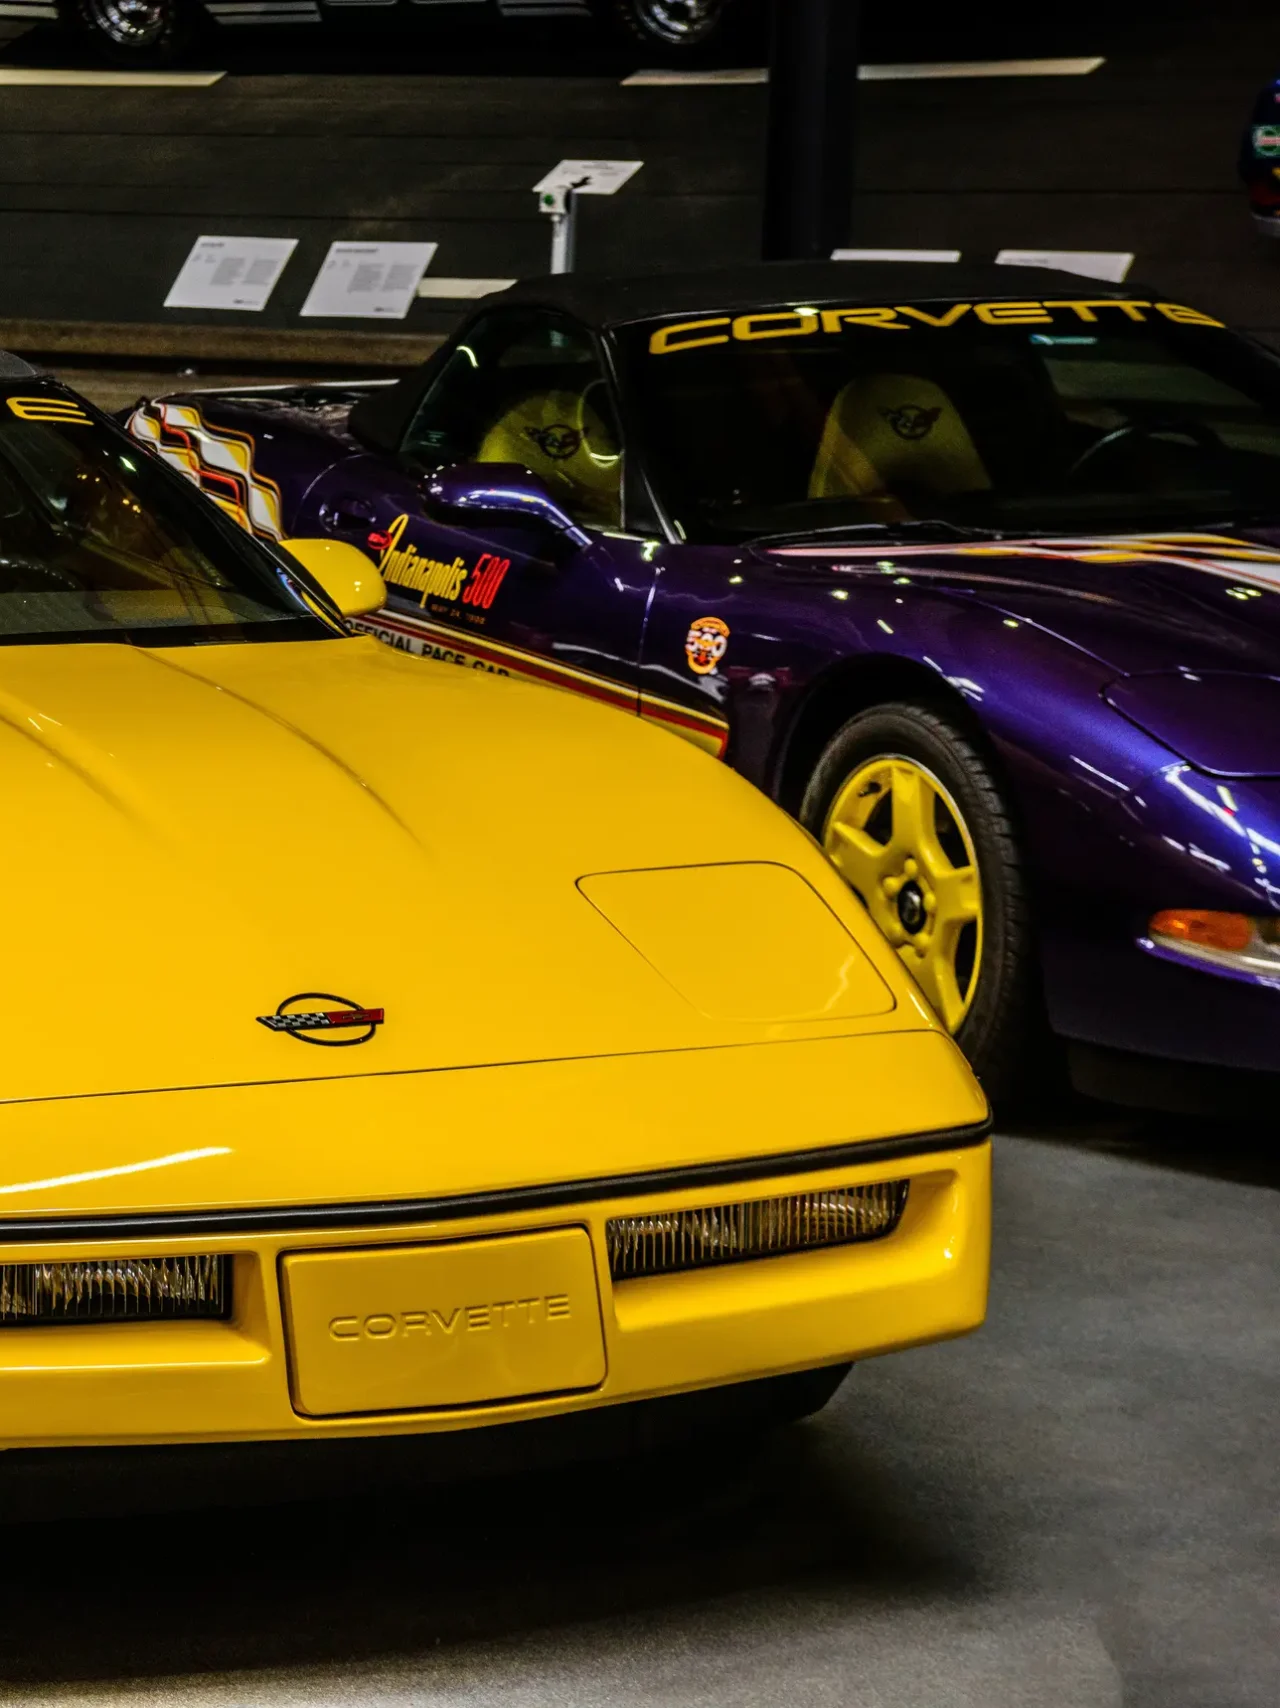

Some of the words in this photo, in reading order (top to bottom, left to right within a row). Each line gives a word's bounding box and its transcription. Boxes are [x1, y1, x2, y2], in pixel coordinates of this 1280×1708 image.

[649, 300, 1227, 355] CORVETTE
[379, 513, 469, 609] Indianapolis
[462, 553, 510, 609] 500
[421, 643, 466, 665] PACE
[328, 1293, 572, 1343] CORVETTE
